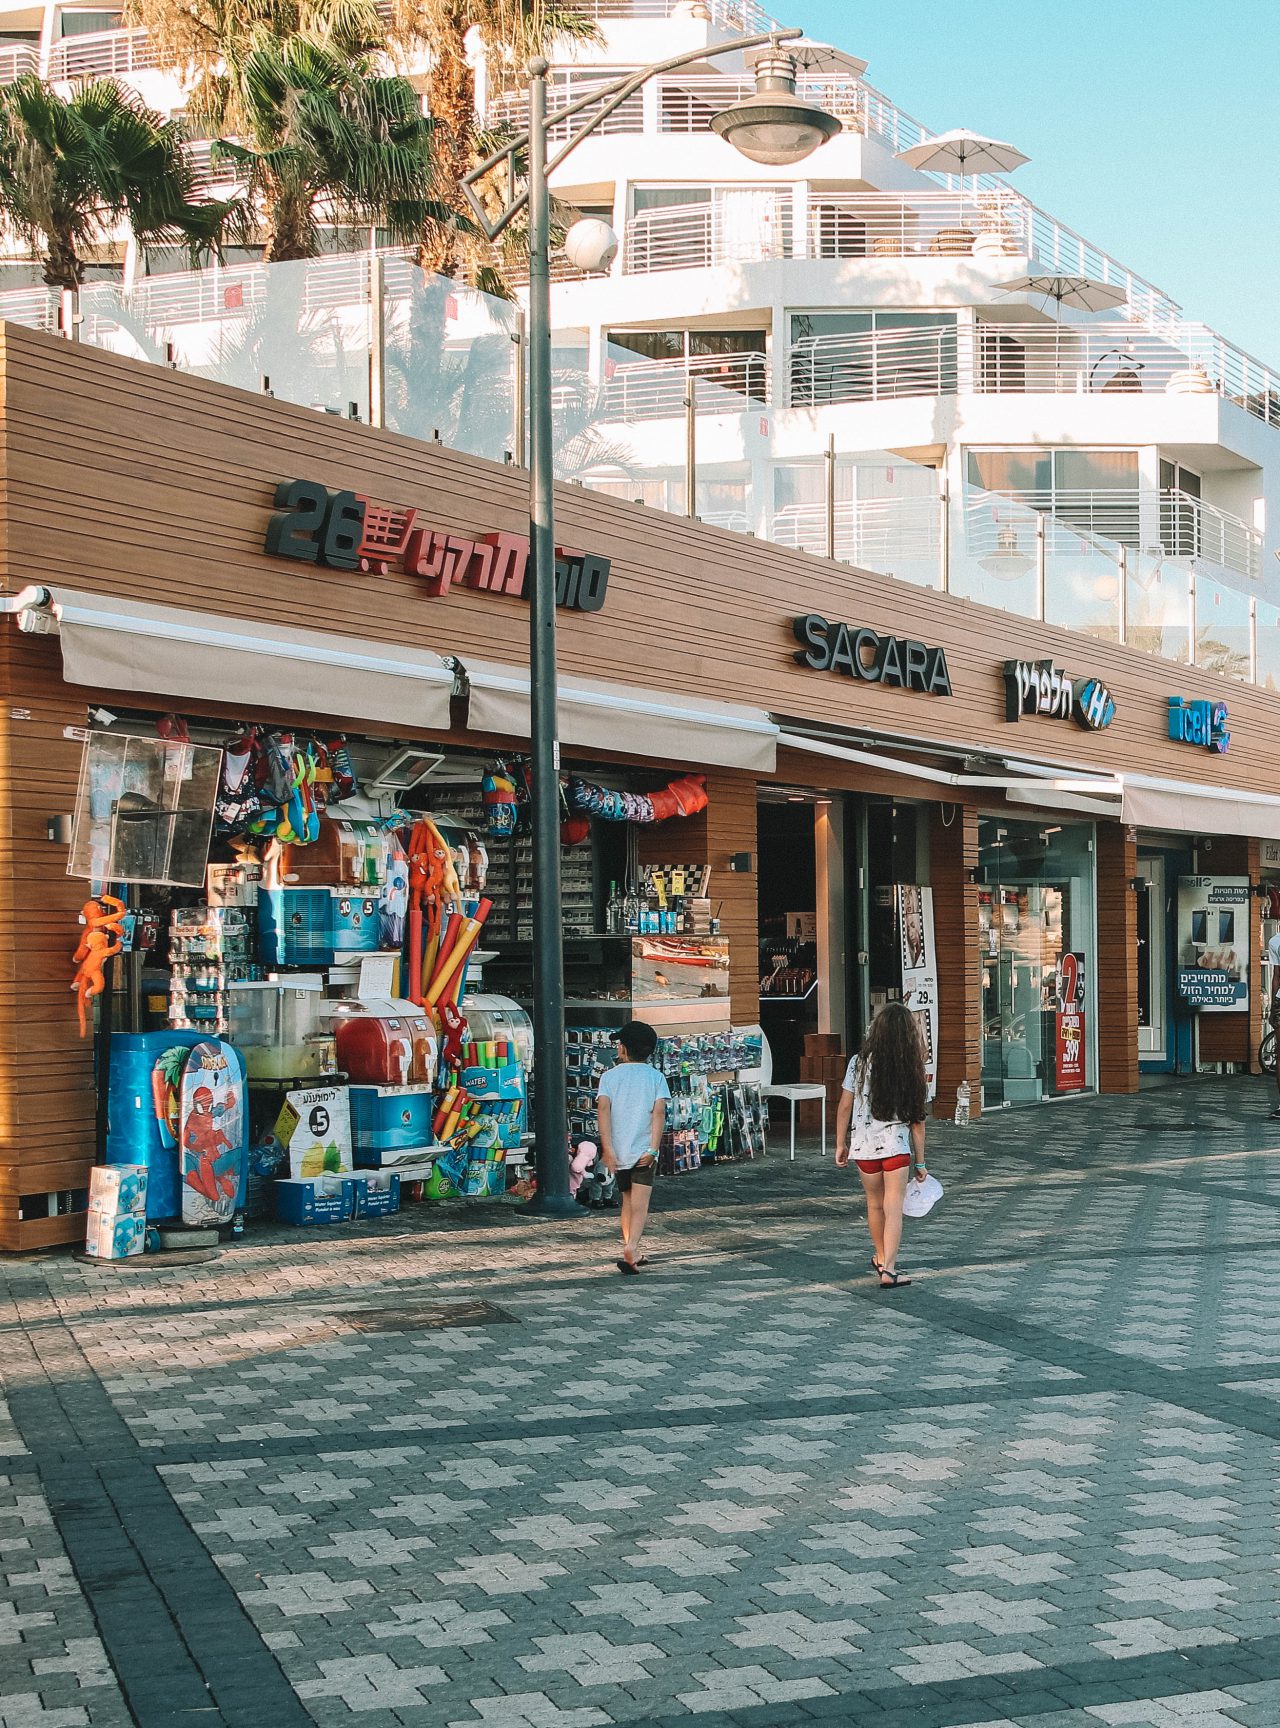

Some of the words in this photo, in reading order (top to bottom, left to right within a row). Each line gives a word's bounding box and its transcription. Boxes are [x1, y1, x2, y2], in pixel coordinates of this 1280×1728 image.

[265, 479, 365, 570] 26
[404, 530, 529, 598] מרקט
[794, 614, 953, 697] SACARA
[1004, 660, 1073, 722] הלפרין
[1266, 844, 1278, 861] Eilat
[1180, 974, 1226, 983] מתחייבים
[1180, 984, 1202, 995] הזול
[1205, 984, 1235, 995] למחיר
[465, 1076, 487, 1087] WATER
